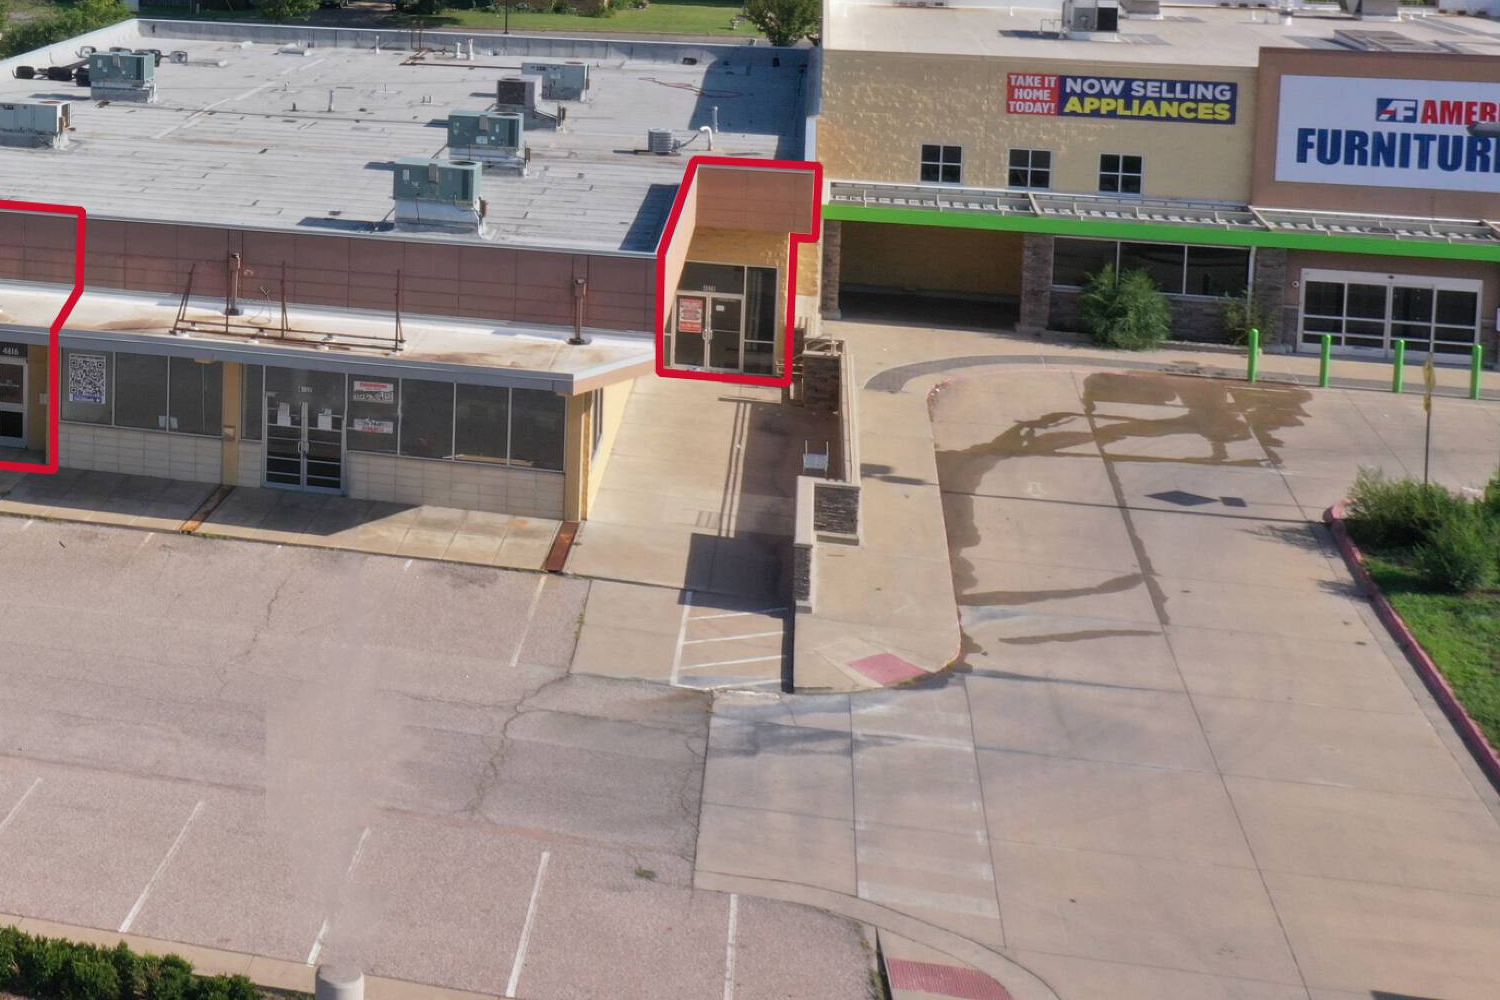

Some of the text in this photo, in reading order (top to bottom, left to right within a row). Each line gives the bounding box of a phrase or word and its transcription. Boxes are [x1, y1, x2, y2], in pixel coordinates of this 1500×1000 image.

[1009, 75, 1057, 87] TAKE IT
[1065, 78, 1232, 100] NOW SELLING
[1014, 88, 1051, 100] HOME
[1008, 101, 1056, 114] TODAY!
[1063, 96, 1231, 121] APPLIANCES
[1420, 100, 1500, 126] AMER
